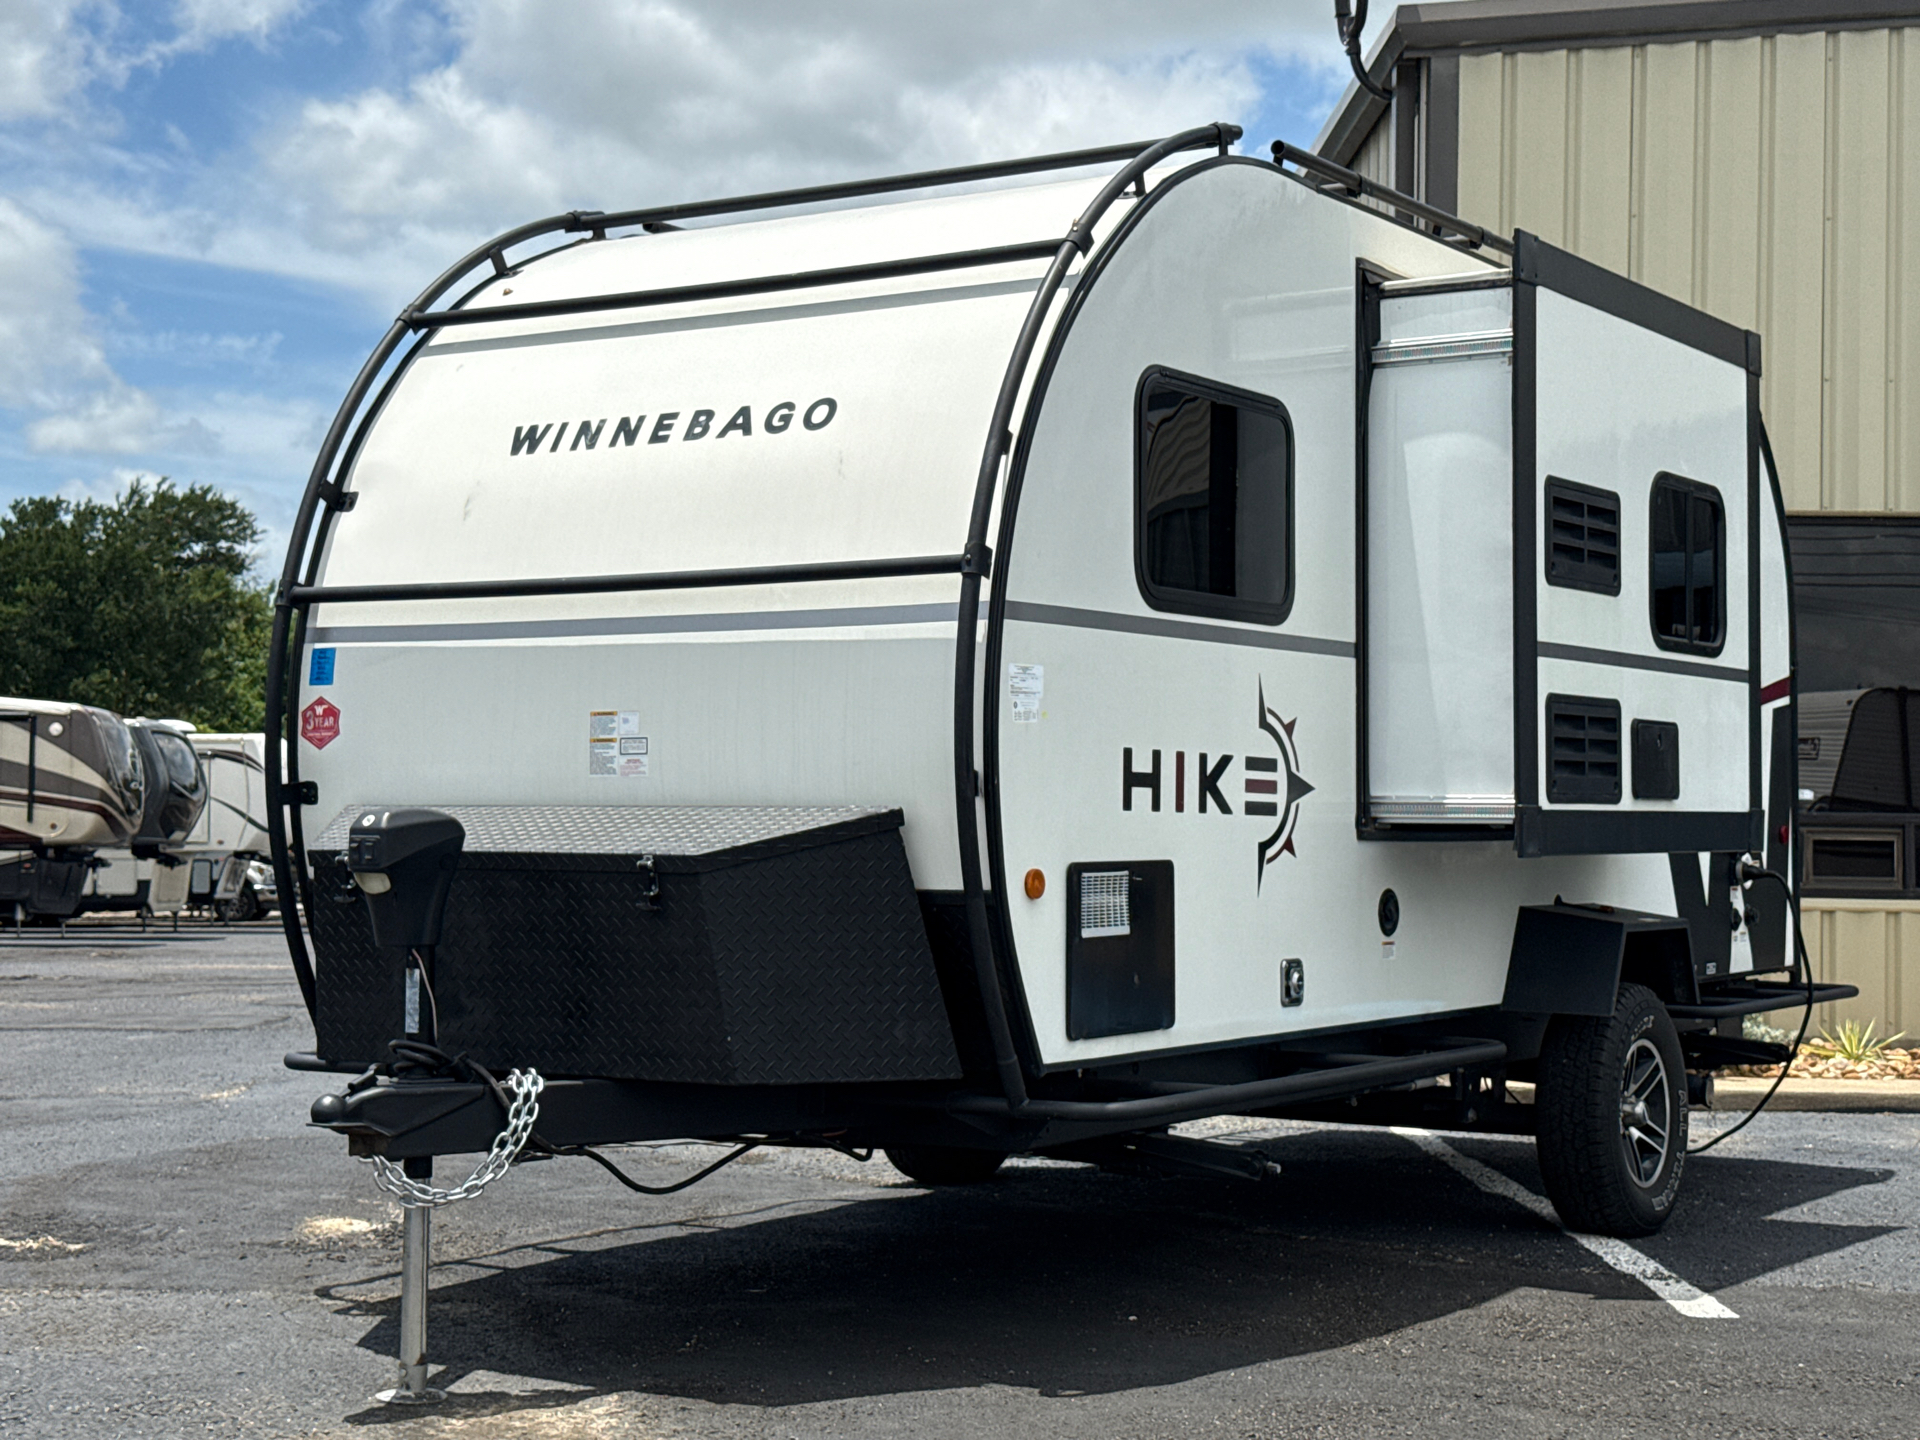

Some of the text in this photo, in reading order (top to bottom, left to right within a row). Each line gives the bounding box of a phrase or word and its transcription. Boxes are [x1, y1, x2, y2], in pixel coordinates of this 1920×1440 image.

[509, 397, 838, 457] WINNEBAGO
[306, 710, 334, 730] 3 YEAR
[1122, 747, 1278, 817] HIKE
